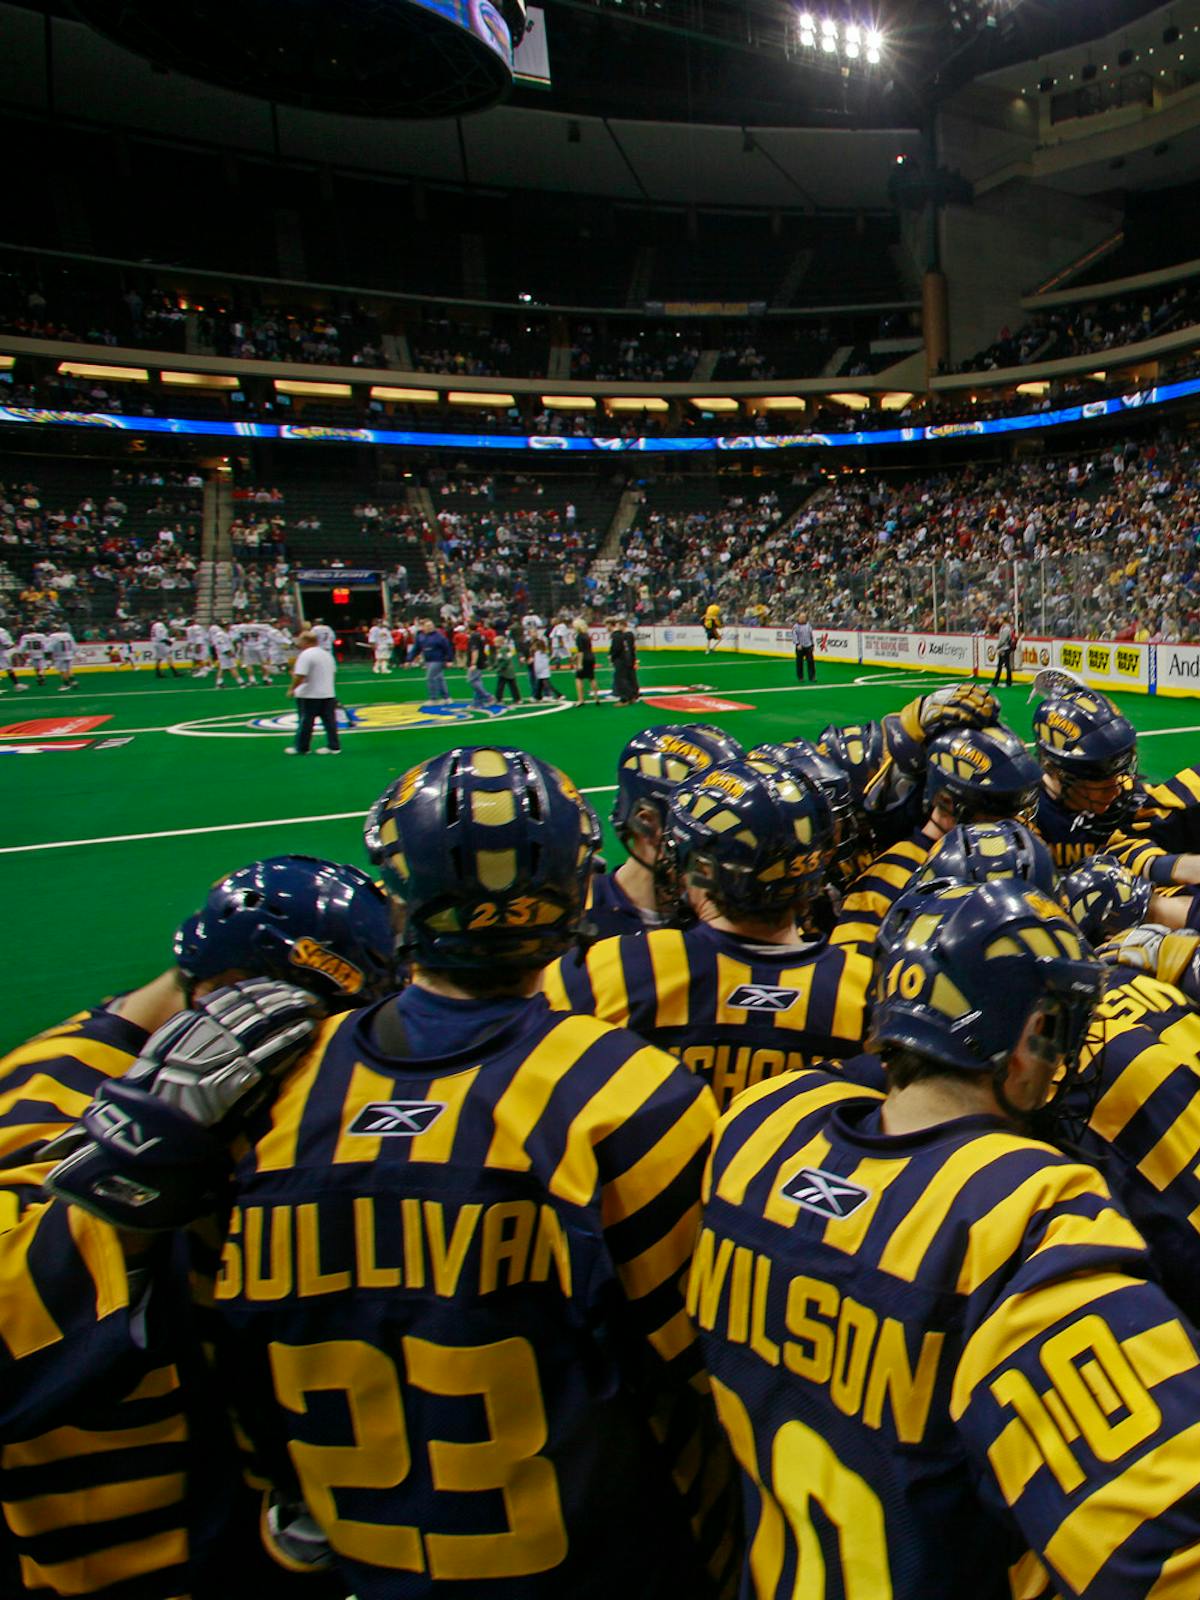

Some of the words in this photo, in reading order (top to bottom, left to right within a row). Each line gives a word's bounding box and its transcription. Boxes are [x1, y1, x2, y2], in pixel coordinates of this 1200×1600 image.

[1062, 647, 1082, 659] BEST
[1062, 658, 1081, 668] BUY
[1089, 648, 1109, 661] BEST
[1089, 659, 1107, 670] BUY
[1117, 650, 1139, 663] BEST
[1117, 661, 1137, 672] BUY
[467, 896, 539, 930] 23
[886, 959, 926, 999] 10
[214, 1197, 573, 1300] SULLIVAN
[686, 1227, 946, 1444] WILSON
[989, 1313, 1163, 1496] 10
[268, 1335, 569, 1581] 23
